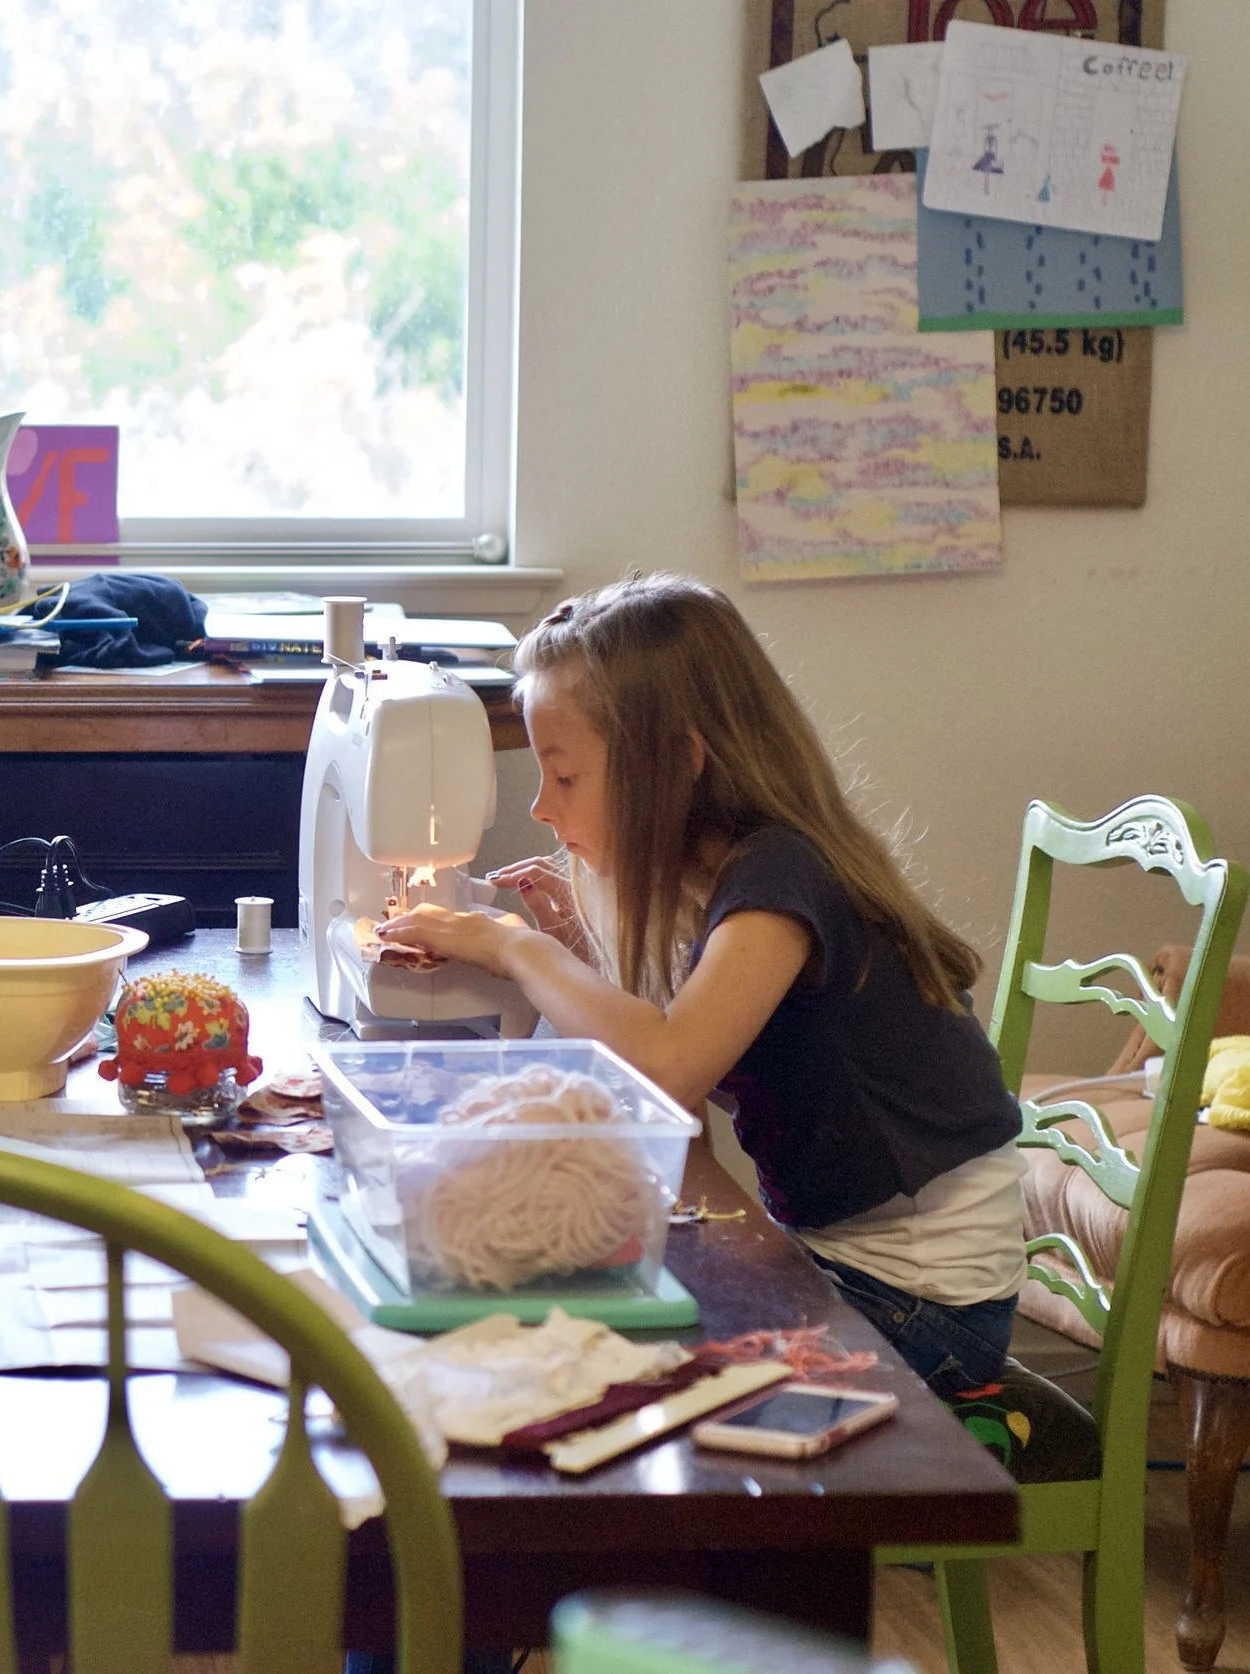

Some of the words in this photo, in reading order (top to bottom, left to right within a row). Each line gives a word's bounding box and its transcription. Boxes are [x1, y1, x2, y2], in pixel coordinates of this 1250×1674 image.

[1003, 329, 1069, 360] (45.5
[1082, 329, 1124, 363] kg)
[999, 386, 1083, 415] 96750
